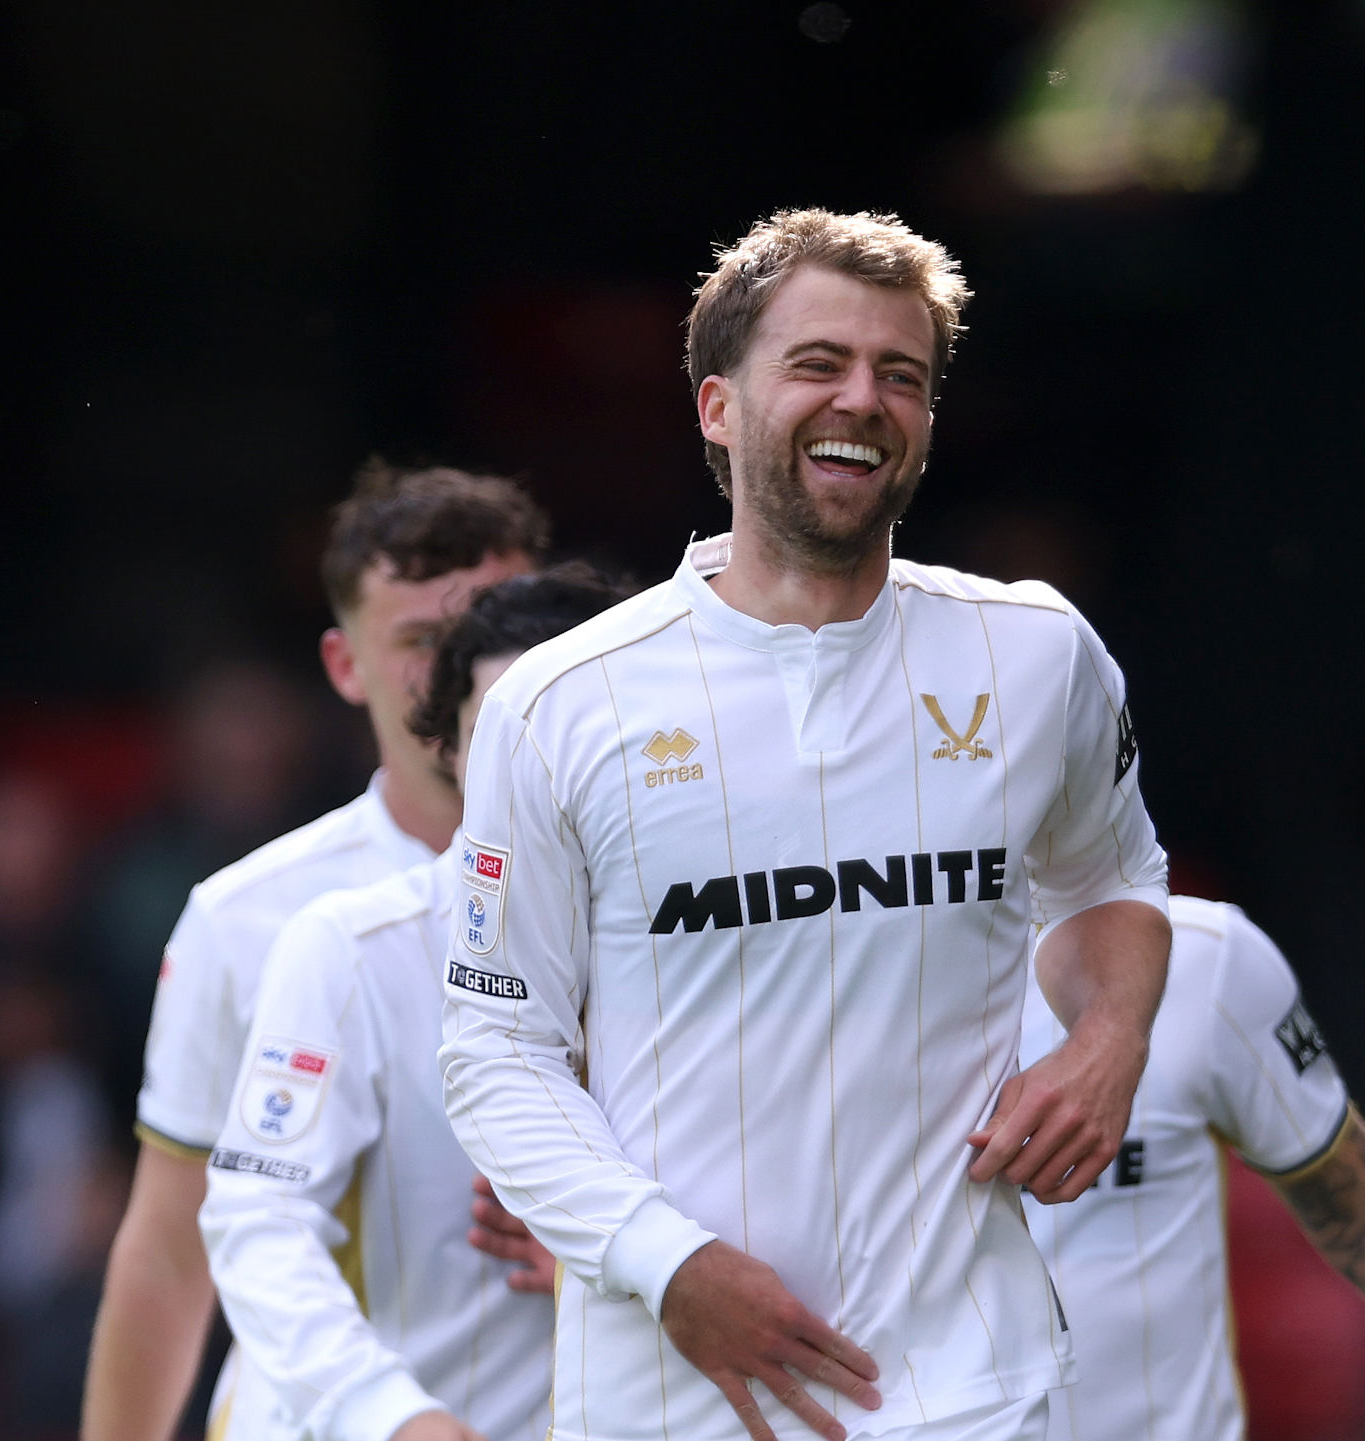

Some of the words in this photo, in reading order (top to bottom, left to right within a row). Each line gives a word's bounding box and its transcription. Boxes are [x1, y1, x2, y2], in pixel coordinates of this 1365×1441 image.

[644, 762, 704, 789] errea
[477, 856, 500, 875] bet
[648, 847, 1007, 935] MIDNITE
[468, 927, 485, 945] EFL
[451, 963, 525, 998] TOGETHER
